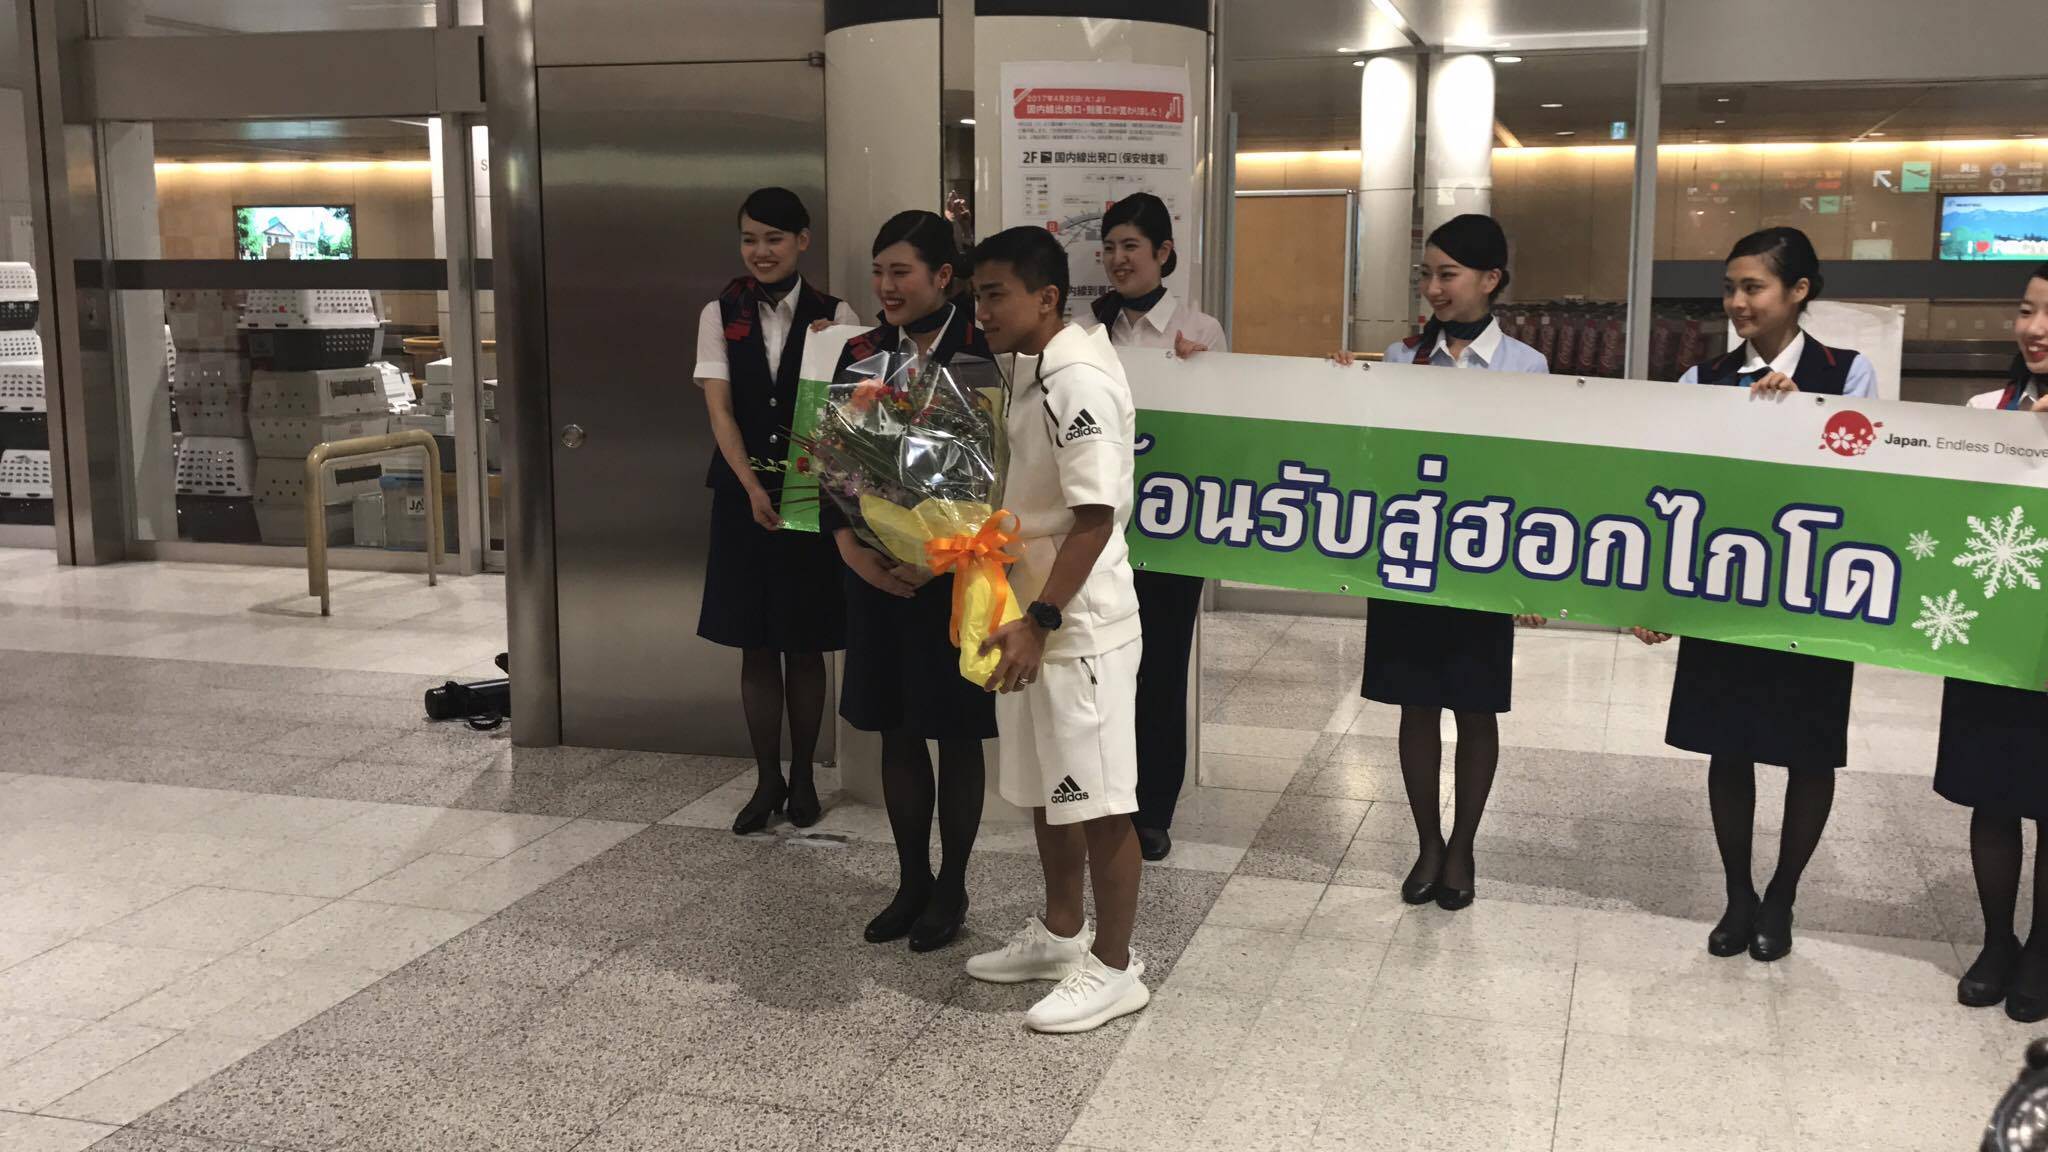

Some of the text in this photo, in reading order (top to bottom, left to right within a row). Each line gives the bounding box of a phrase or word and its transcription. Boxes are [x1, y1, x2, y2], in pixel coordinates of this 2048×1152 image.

[1023, 152, 1037, 163] 2F
[1066, 425, 1102, 440] adidas
[1885, 433, 2048, 458] Japan. Endless Discove
[1134, 431, 1901, 626] อนรับสู่ฮอกไกโด
[1051, 791, 1089, 804] adidas
